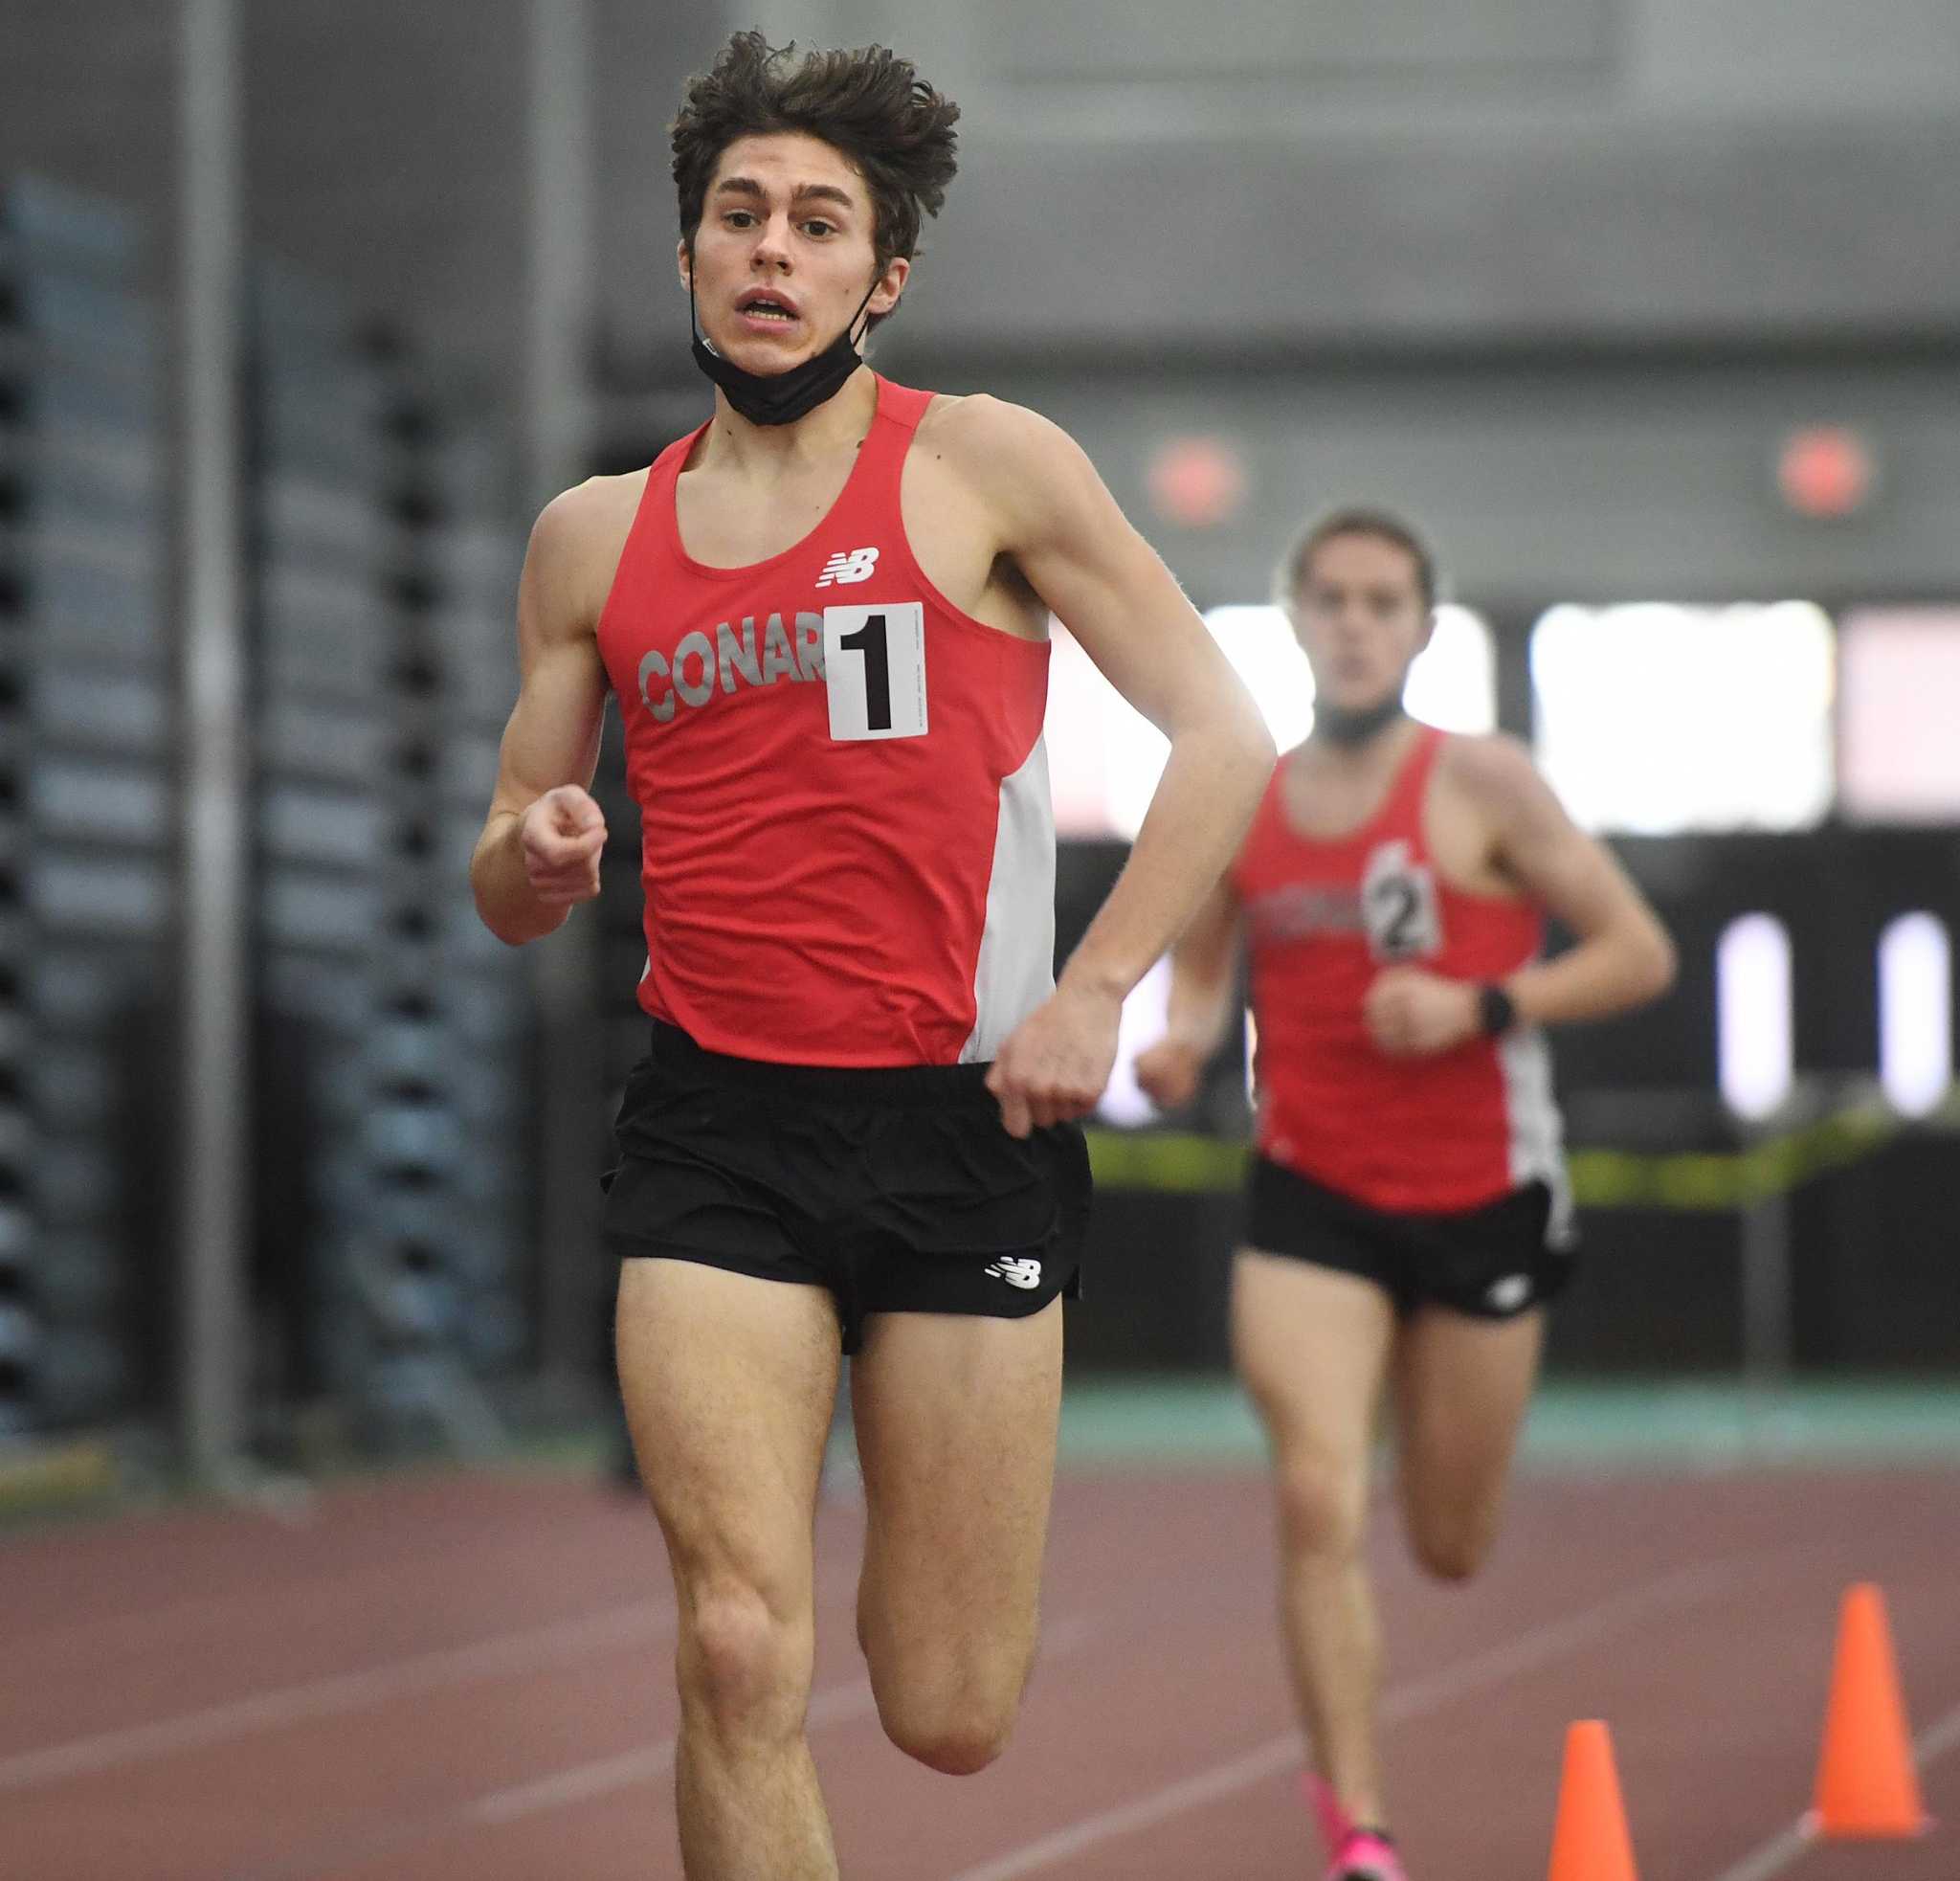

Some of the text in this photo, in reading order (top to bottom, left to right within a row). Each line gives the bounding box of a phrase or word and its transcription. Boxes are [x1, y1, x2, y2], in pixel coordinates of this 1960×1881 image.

[638, 611, 826, 722] CONAR
[840, 614, 892, 730] 1
[1372, 875, 1427, 948] 2
